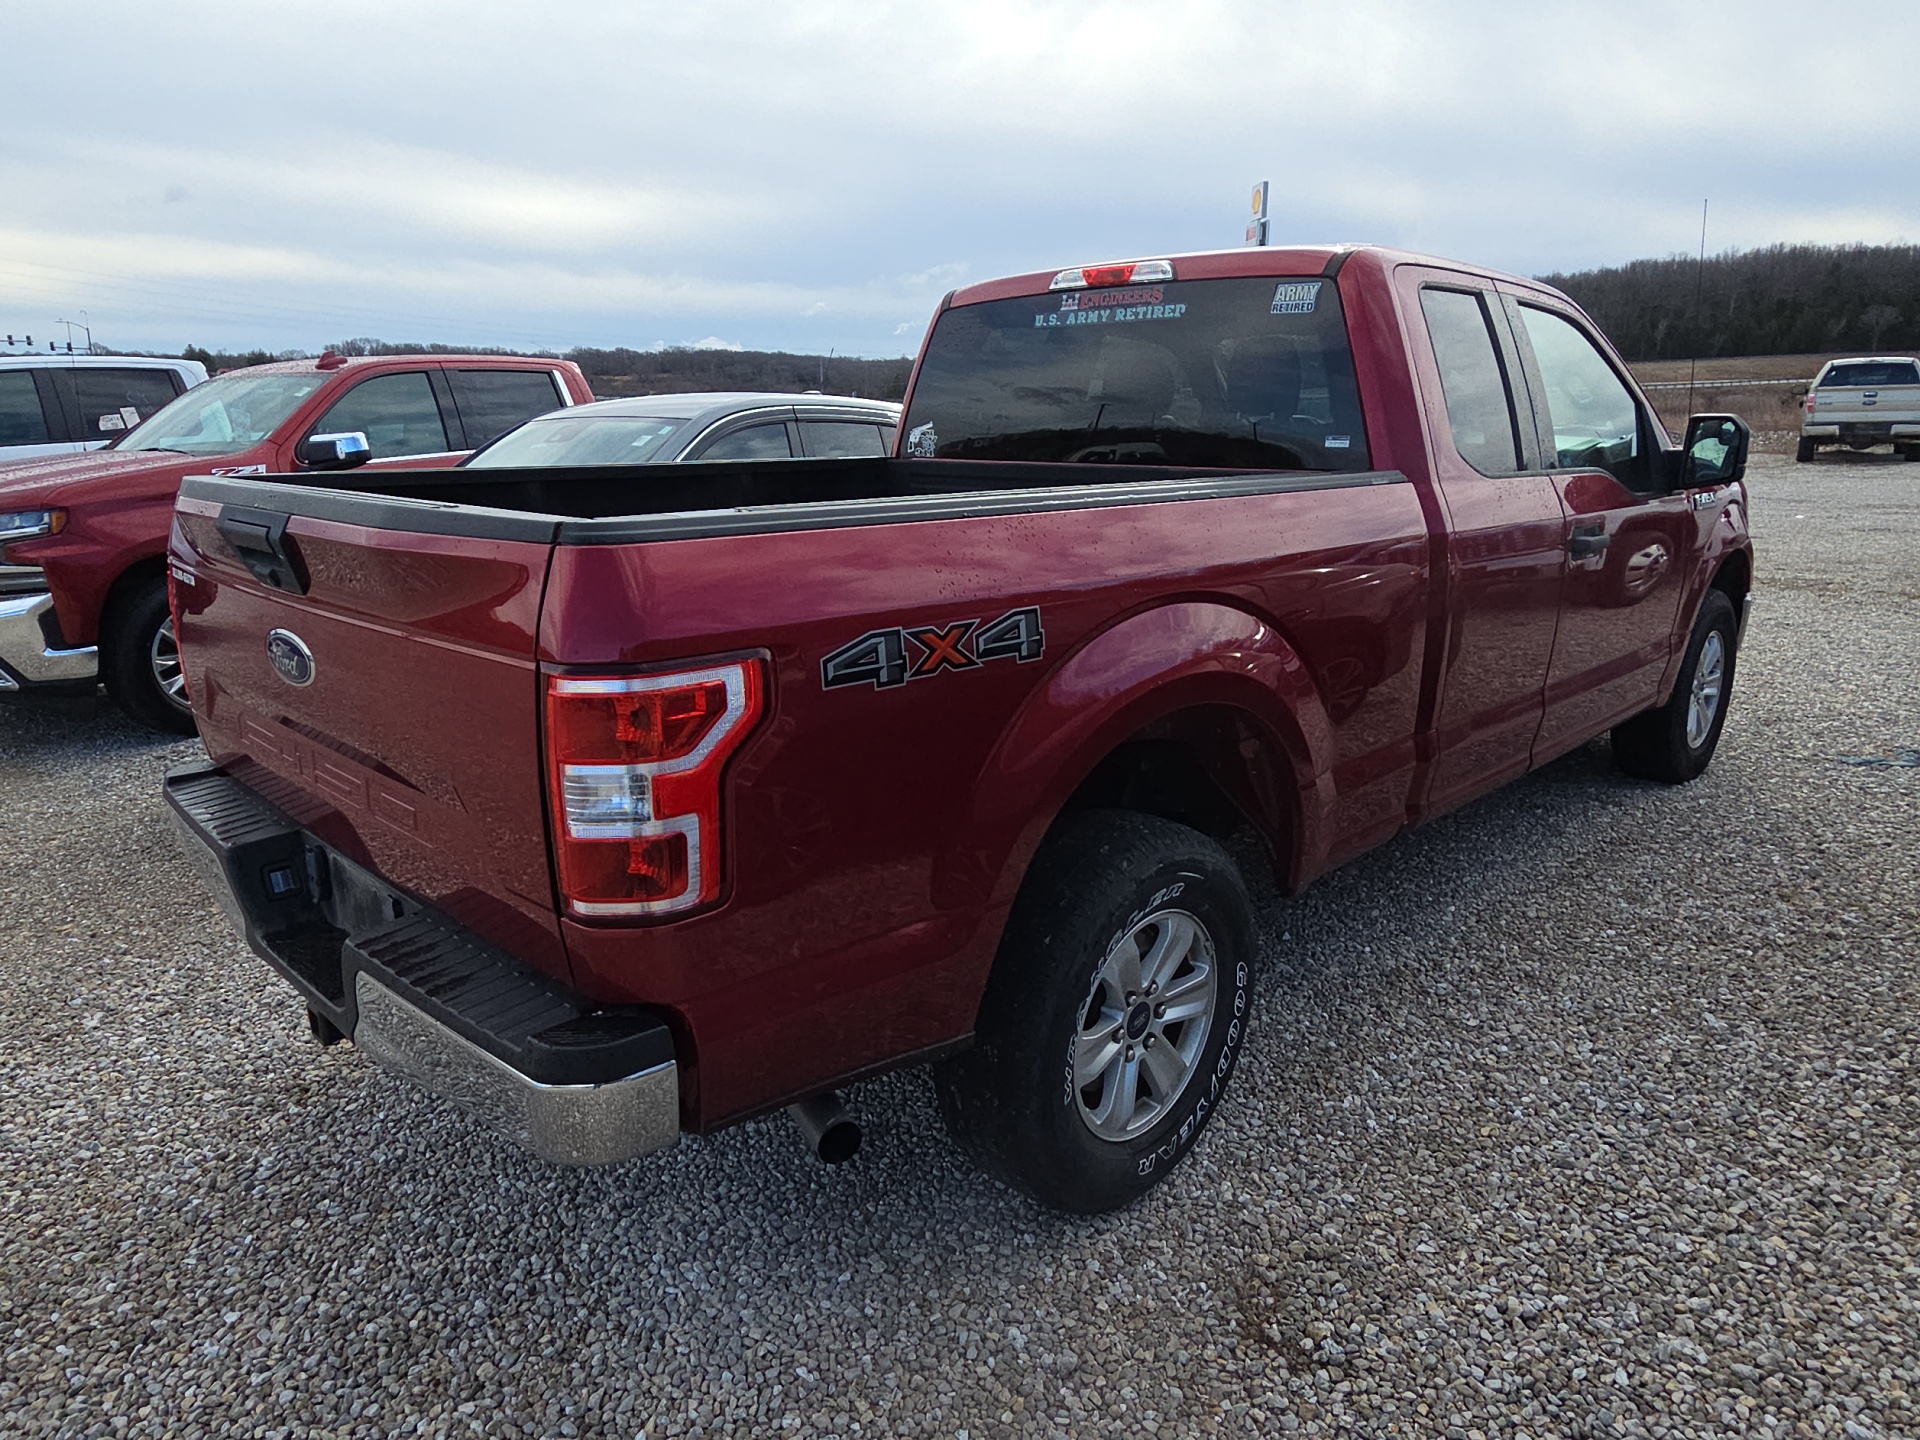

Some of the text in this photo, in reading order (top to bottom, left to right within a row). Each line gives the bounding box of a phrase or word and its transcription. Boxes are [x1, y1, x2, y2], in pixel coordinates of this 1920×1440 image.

[1079, 287, 1164, 309] ENGINEERS
[1275, 284, 1320, 302] ARMY
[1034, 303, 1187, 327] U.S. ARMY RETIRED
[1272, 302, 1314, 313] RETIRED
[270, 638, 300, 676] Ford
[1137, 961, 1249, 1176] GOODYEAR
